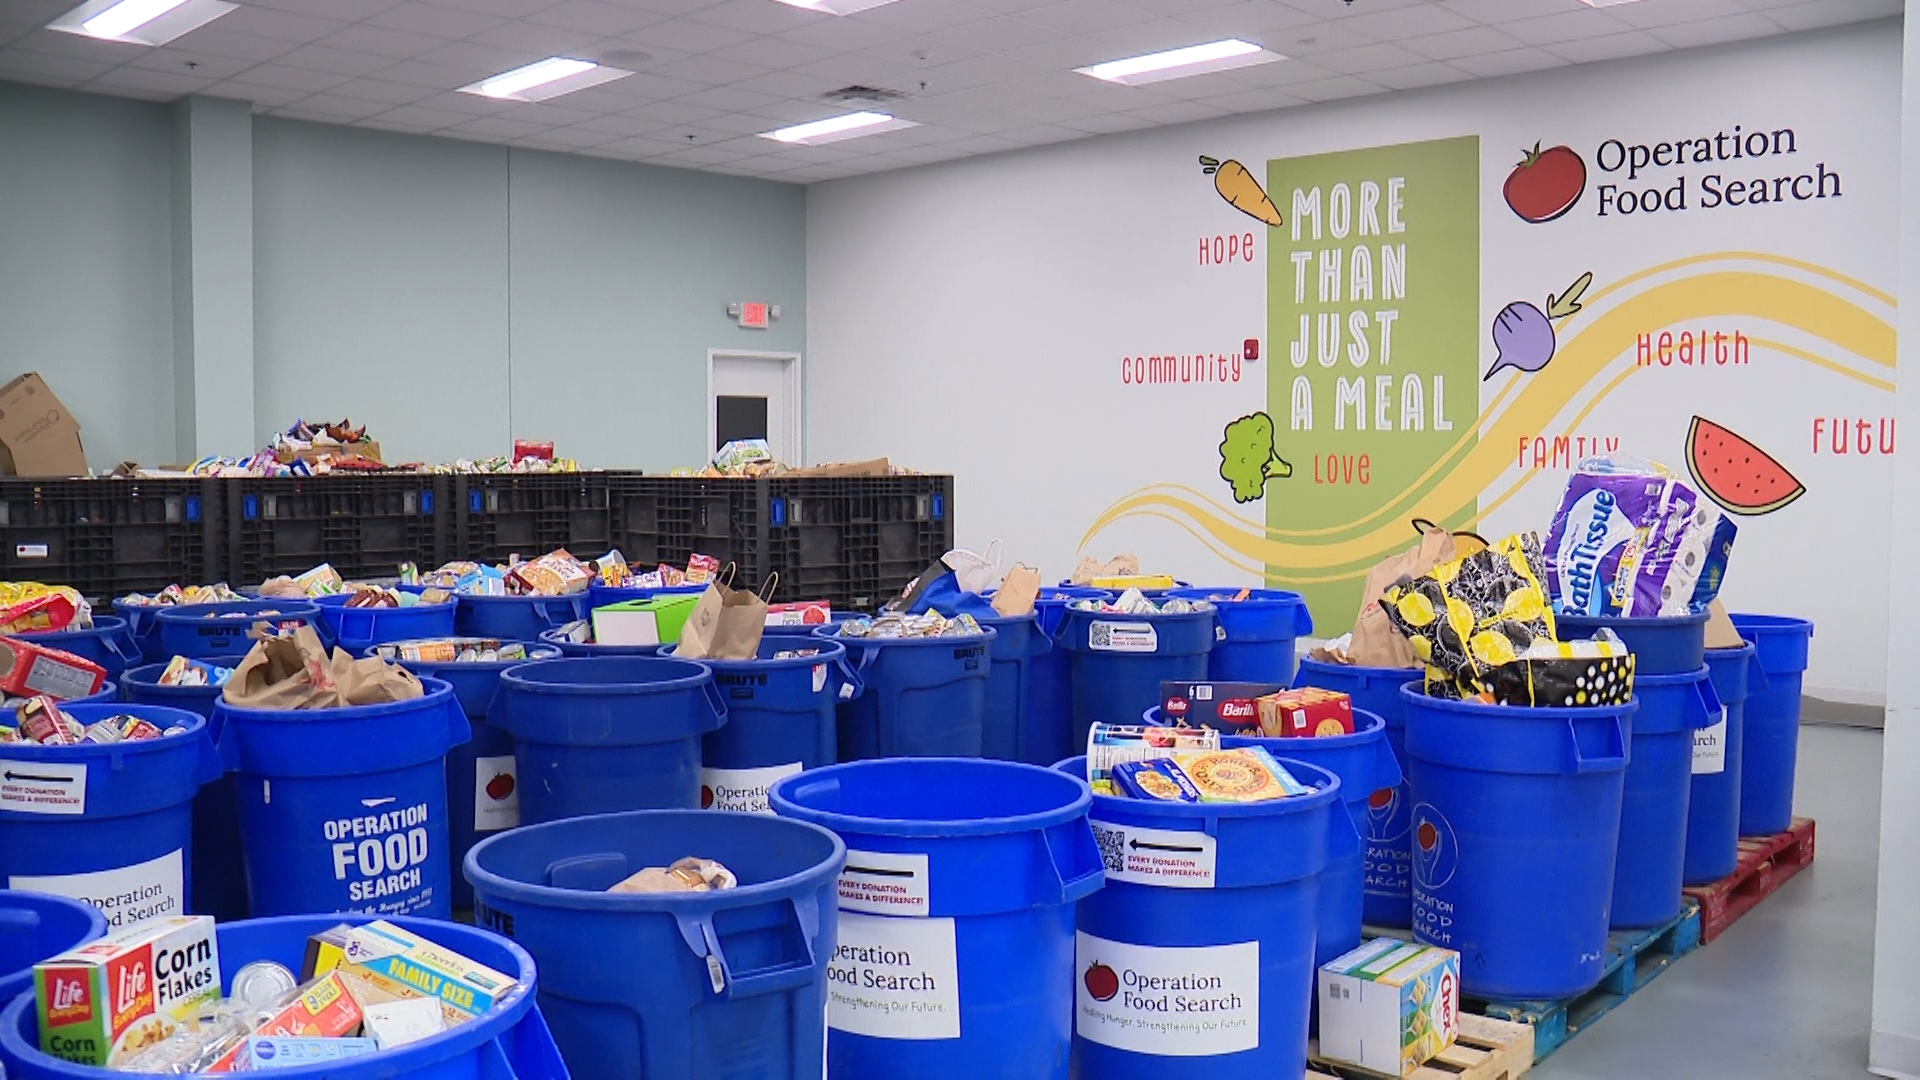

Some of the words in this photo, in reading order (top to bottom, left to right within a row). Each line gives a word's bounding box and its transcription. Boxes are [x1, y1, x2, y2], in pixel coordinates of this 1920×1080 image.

[1597, 125, 1797, 180] Operation
[1597, 177, 1688, 217] Food
[1700, 162, 1842, 209] Search
[1291, 177, 1406, 241] MORE
[1290, 243, 1406, 304] THAN
[1290, 308, 1399, 368] JUST
[1637, 330, 1750, 366] Health
[1121, 353, 1241, 384] community
[1290, 375, 1313, 431] A
[1335, 372, 1454, 431] MEAL
[324, 803, 428, 841] OPERATION
[332, 827, 429, 880] FOOD
[1127, 855, 1151, 864] EVERY
[1152, 857, 1196, 868] DONATION
[1127, 864, 1154, 874] MAKES
[1162, 869, 1211, 878] DIFFERENCE!
[349, 867, 421, 901] SEARCH
[838, 879, 860, 889] EVERY
[862, 883, 907, 894] DONATION
[838, 889, 864, 901] MAKES
[872, 895, 924, 906] DIFFERENCE!
[127, 895, 175, 925] Search
[155, 937, 212, 980] Corn
[53, 976, 84, 1010] Life
[117, 961, 146, 1014] Life
[157, 966, 213, 1006] Flakes
[387, 957, 443, 995] FAMILY
[441, 983, 475, 1010] SIZE
[863, 968, 936, 992] Search
[1123, 969, 1222, 993] Operation
[830, 991, 889, 1014] Strengthening
[891, 1001, 909, 1012] Our
[1123, 991, 1168, 1013] Food
[1175, 992, 1242, 1013] Search
[1441, 973, 1453, 1034] Chex
[50, 1035, 96, 1052] Corn
[1136, 1018, 1201, 1034] Strengthening
[1202, 1021, 1218, 1031] Our
